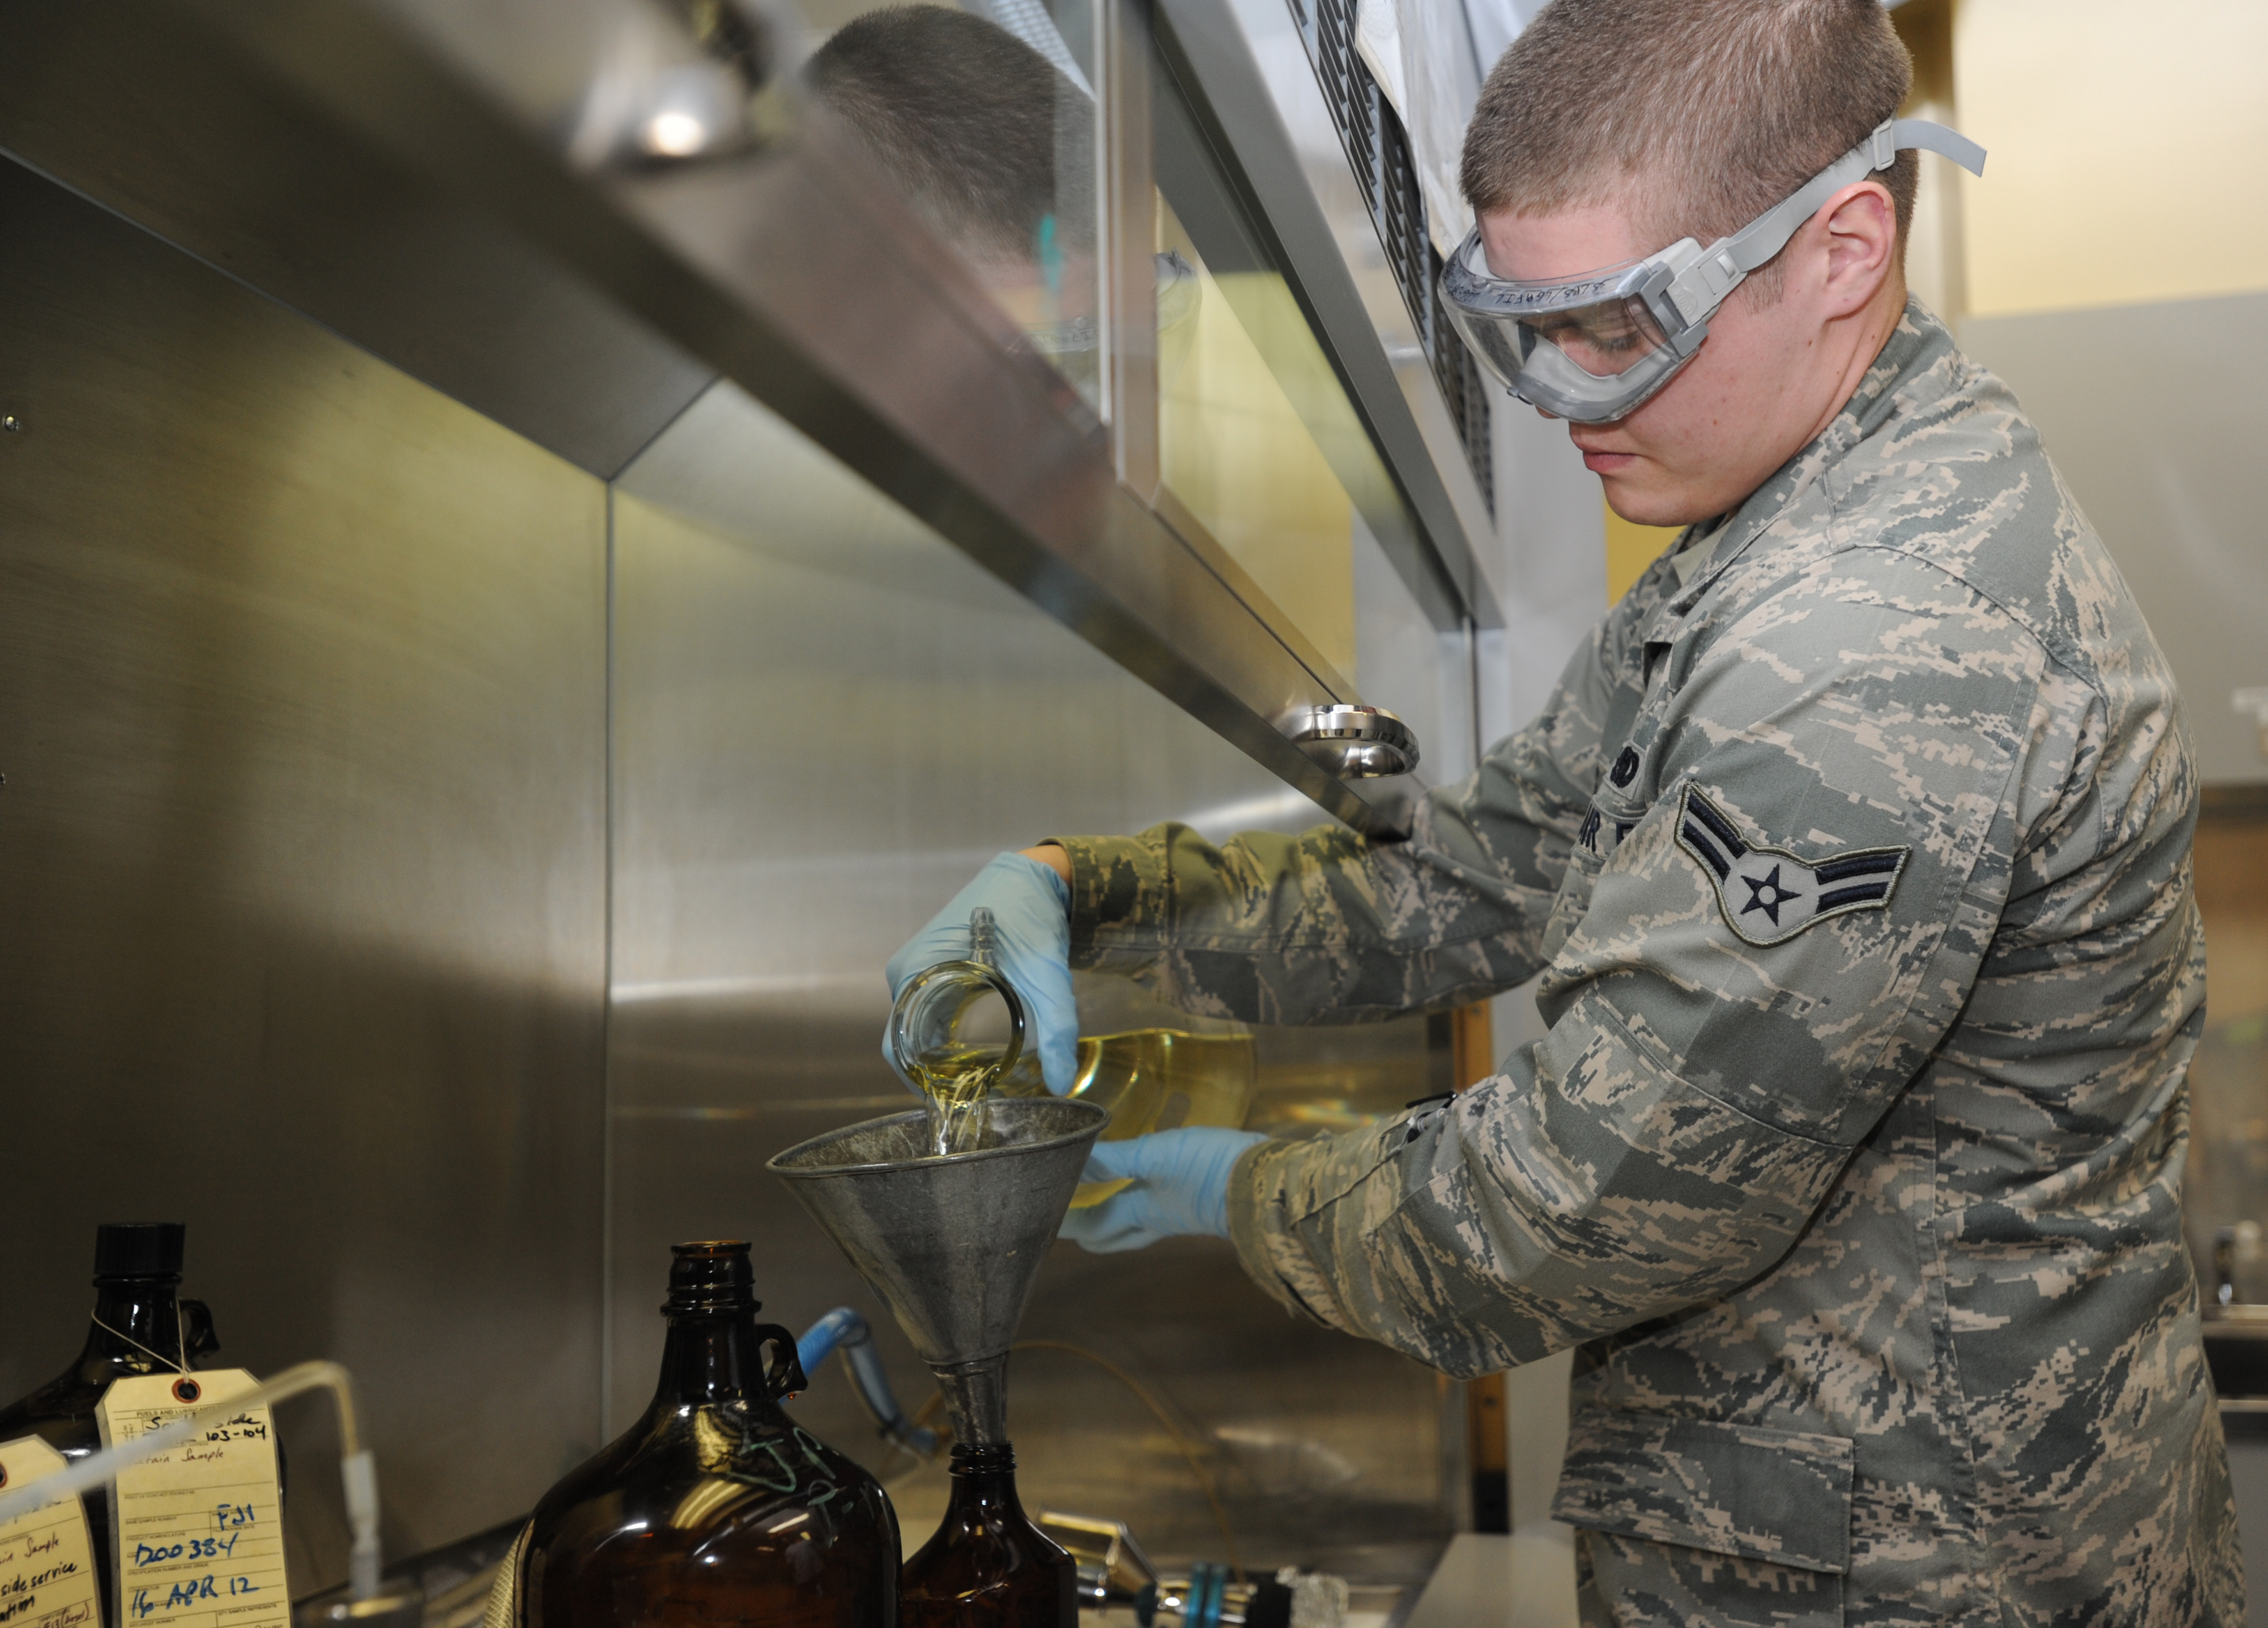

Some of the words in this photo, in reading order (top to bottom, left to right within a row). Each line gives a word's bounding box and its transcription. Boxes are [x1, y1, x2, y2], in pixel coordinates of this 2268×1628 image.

[206, 1424, 266, 1441] 103-104
[181, 1446, 224, 1462] Sample
[166, 1574, 218, 1610] APR
[230, 1577, 260, 1596] 12
